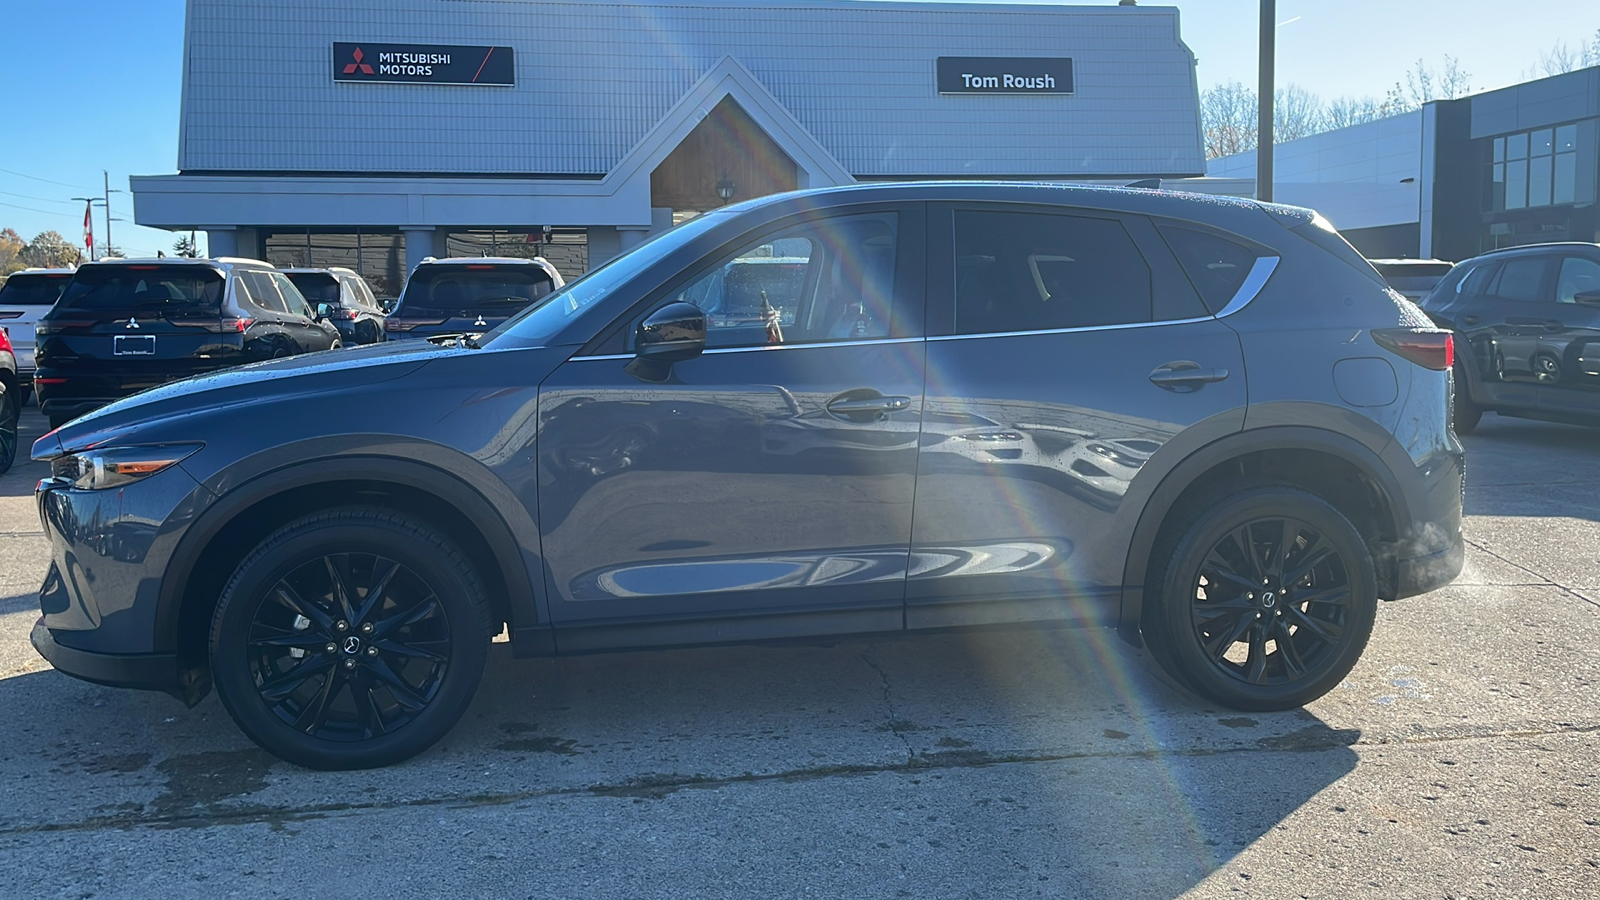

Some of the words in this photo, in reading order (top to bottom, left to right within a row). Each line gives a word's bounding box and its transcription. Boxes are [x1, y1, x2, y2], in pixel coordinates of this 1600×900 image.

[379, 52, 451, 64] MITSUBISHI
[379, 64, 433, 76] MOTORS
[961, 73, 999, 88] Tom
[1003, 73, 1055, 88] Roush
